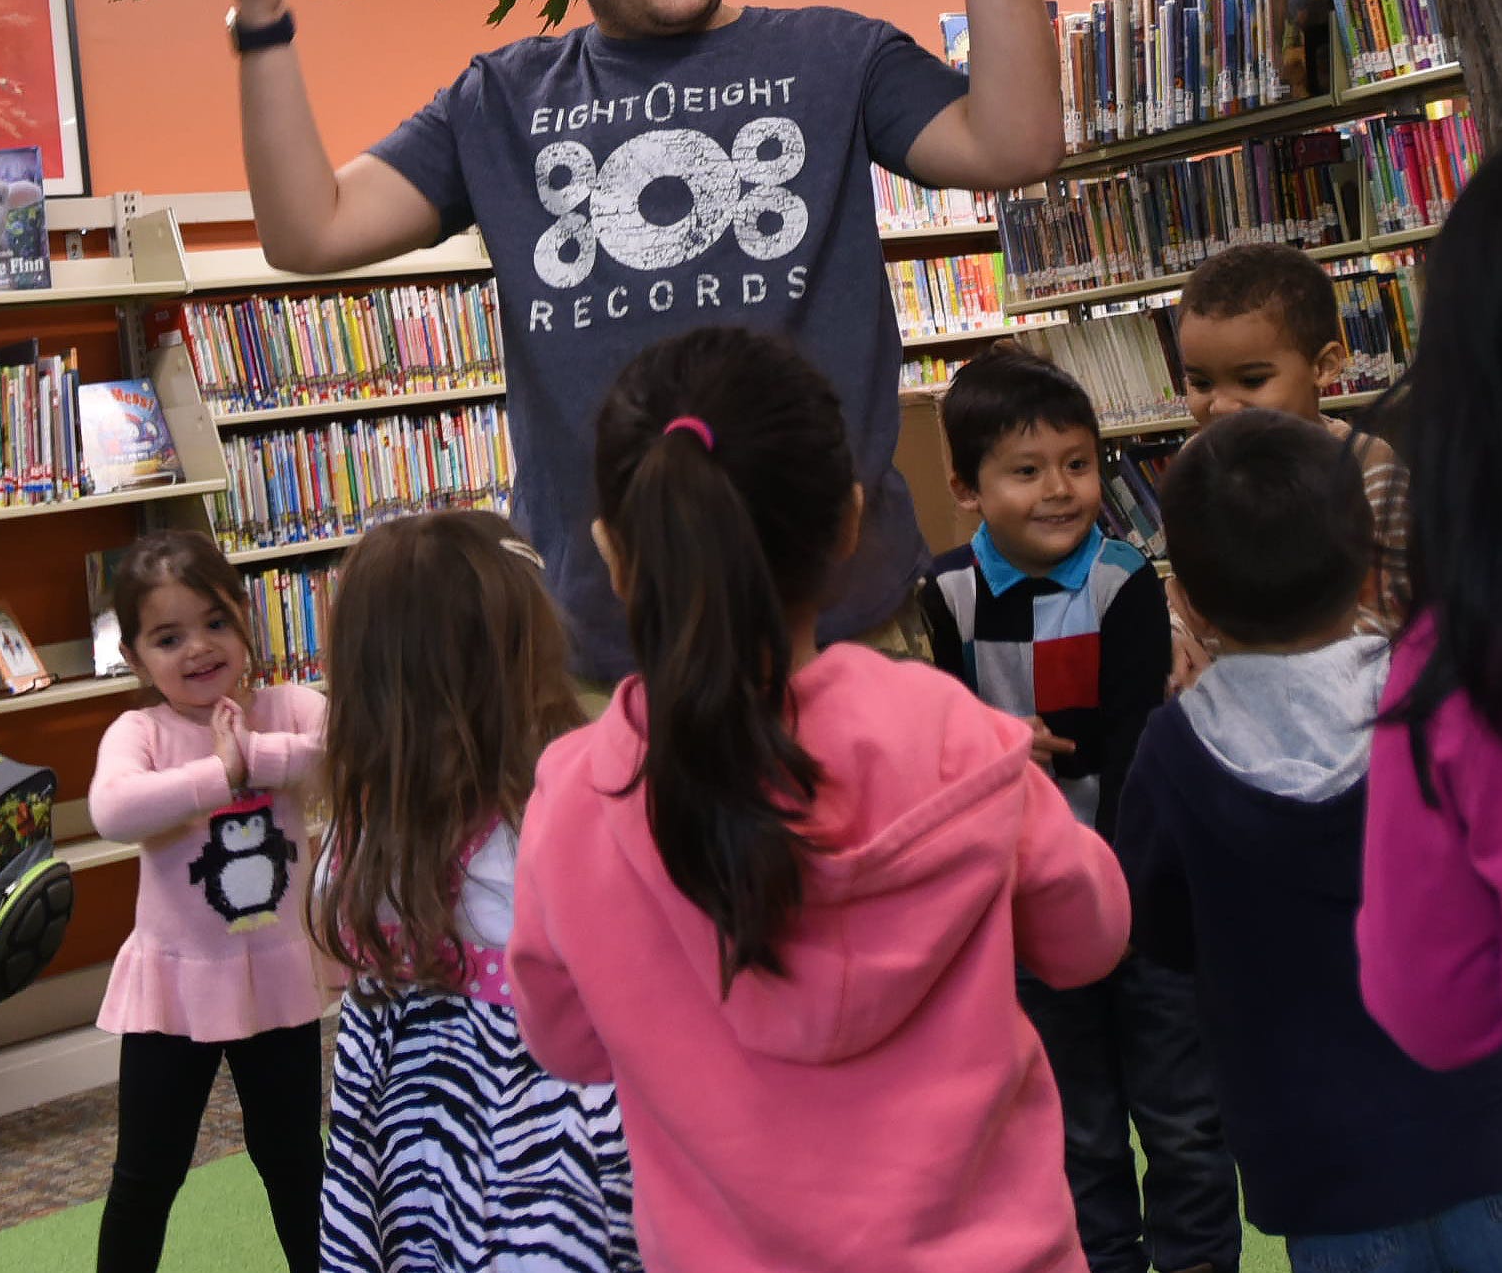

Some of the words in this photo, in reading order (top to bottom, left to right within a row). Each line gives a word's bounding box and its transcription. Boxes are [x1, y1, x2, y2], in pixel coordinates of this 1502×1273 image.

[533, 117, 808, 289] 808
[10, 257, 44, 275] Finn
[529, 266, 807, 333] RECORDS
